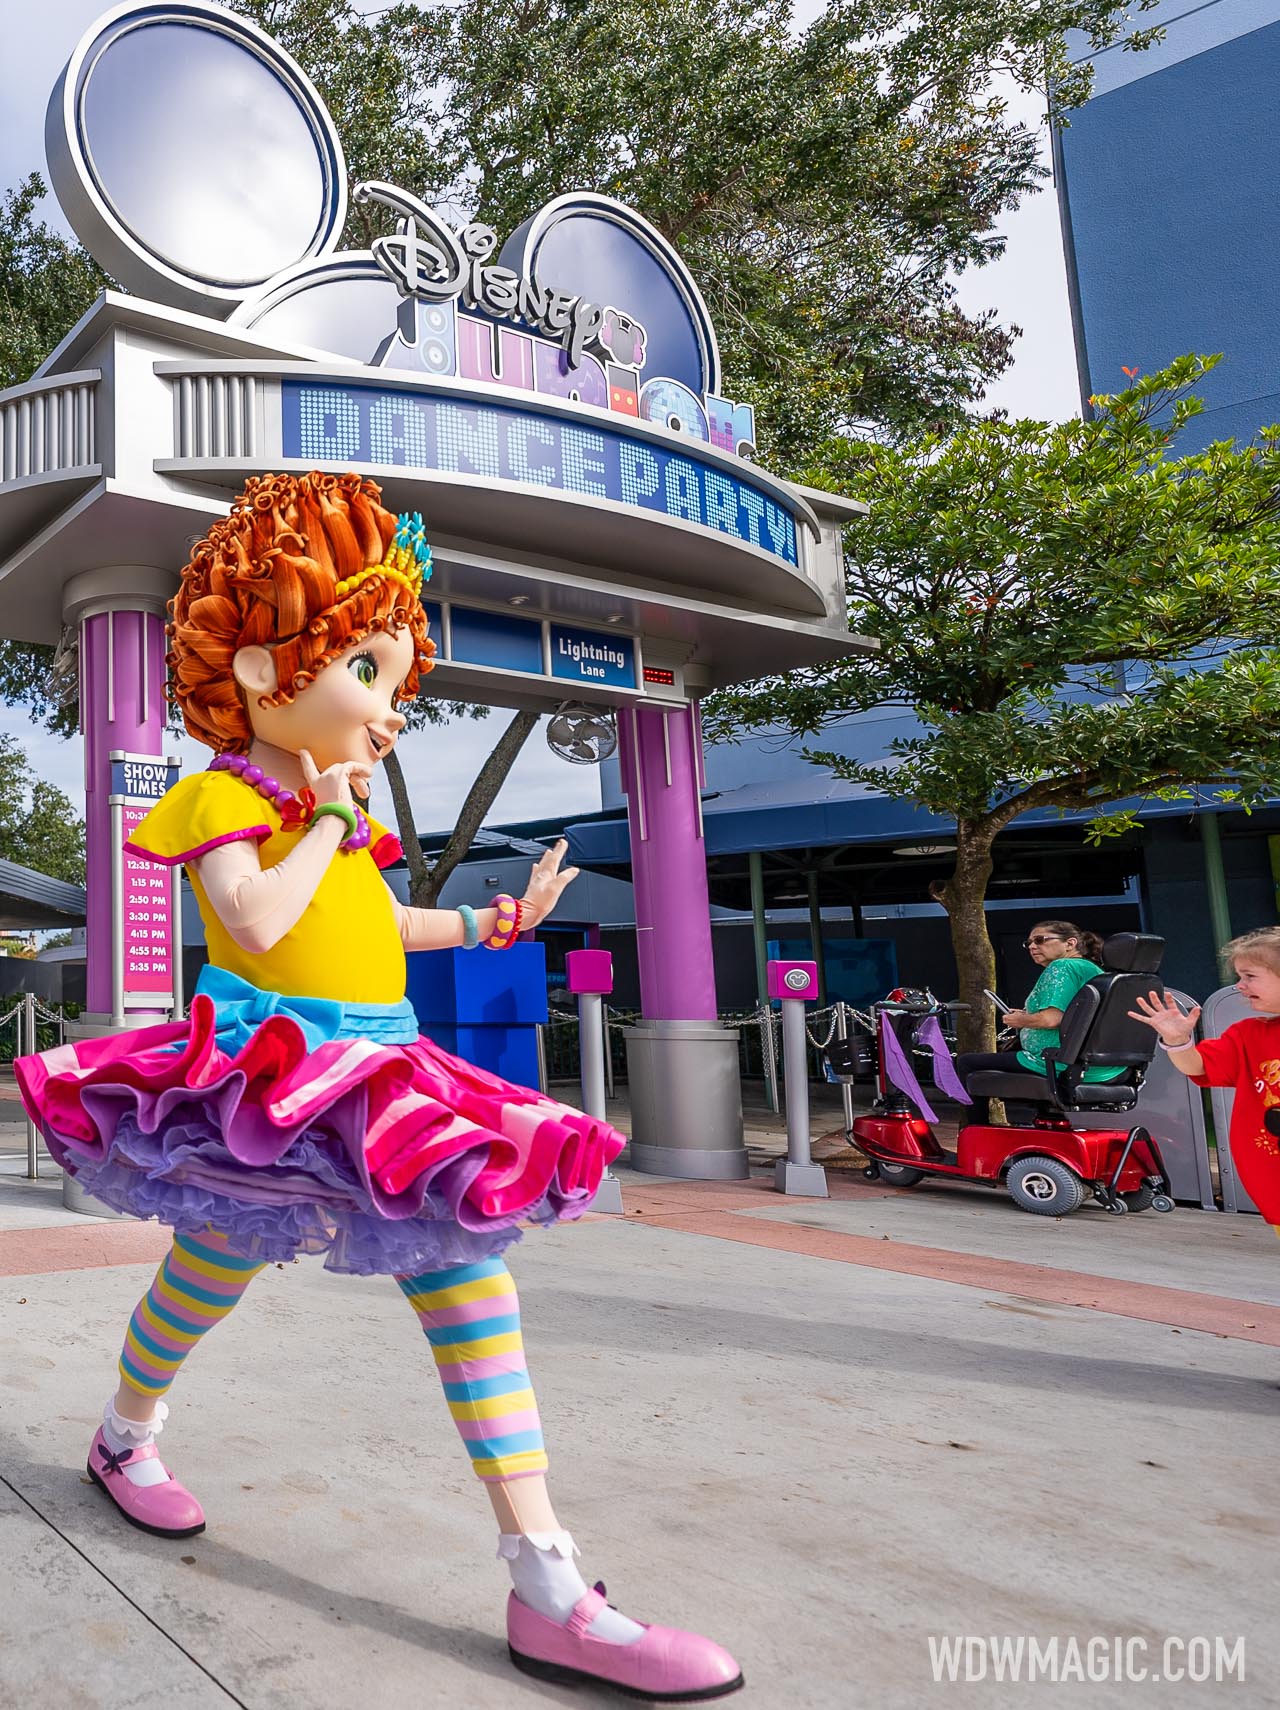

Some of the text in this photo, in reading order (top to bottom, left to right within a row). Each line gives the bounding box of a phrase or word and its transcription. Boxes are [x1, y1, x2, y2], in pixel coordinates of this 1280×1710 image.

[354, 180, 604, 370] Disney
[300, 390, 796, 567] DANCE PARTY!
[559, 637, 625, 669] Lightning
[580, 661, 606, 678] Lane
[124, 763, 168, 782] SHOW
[125, 779, 167, 797] TIMES
[127, 860, 168, 872] 12:35 PM
[131, 878, 164, 888] 1:15 PM
[129, 895, 167, 906] 2:50 PM
[129, 912, 167, 922] 3:30 PM
[130, 929, 166, 940] 4:15 PM
[129, 946, 167, 956] 4:55 PM
[129, 962, 167, 972] 5:35 PM
